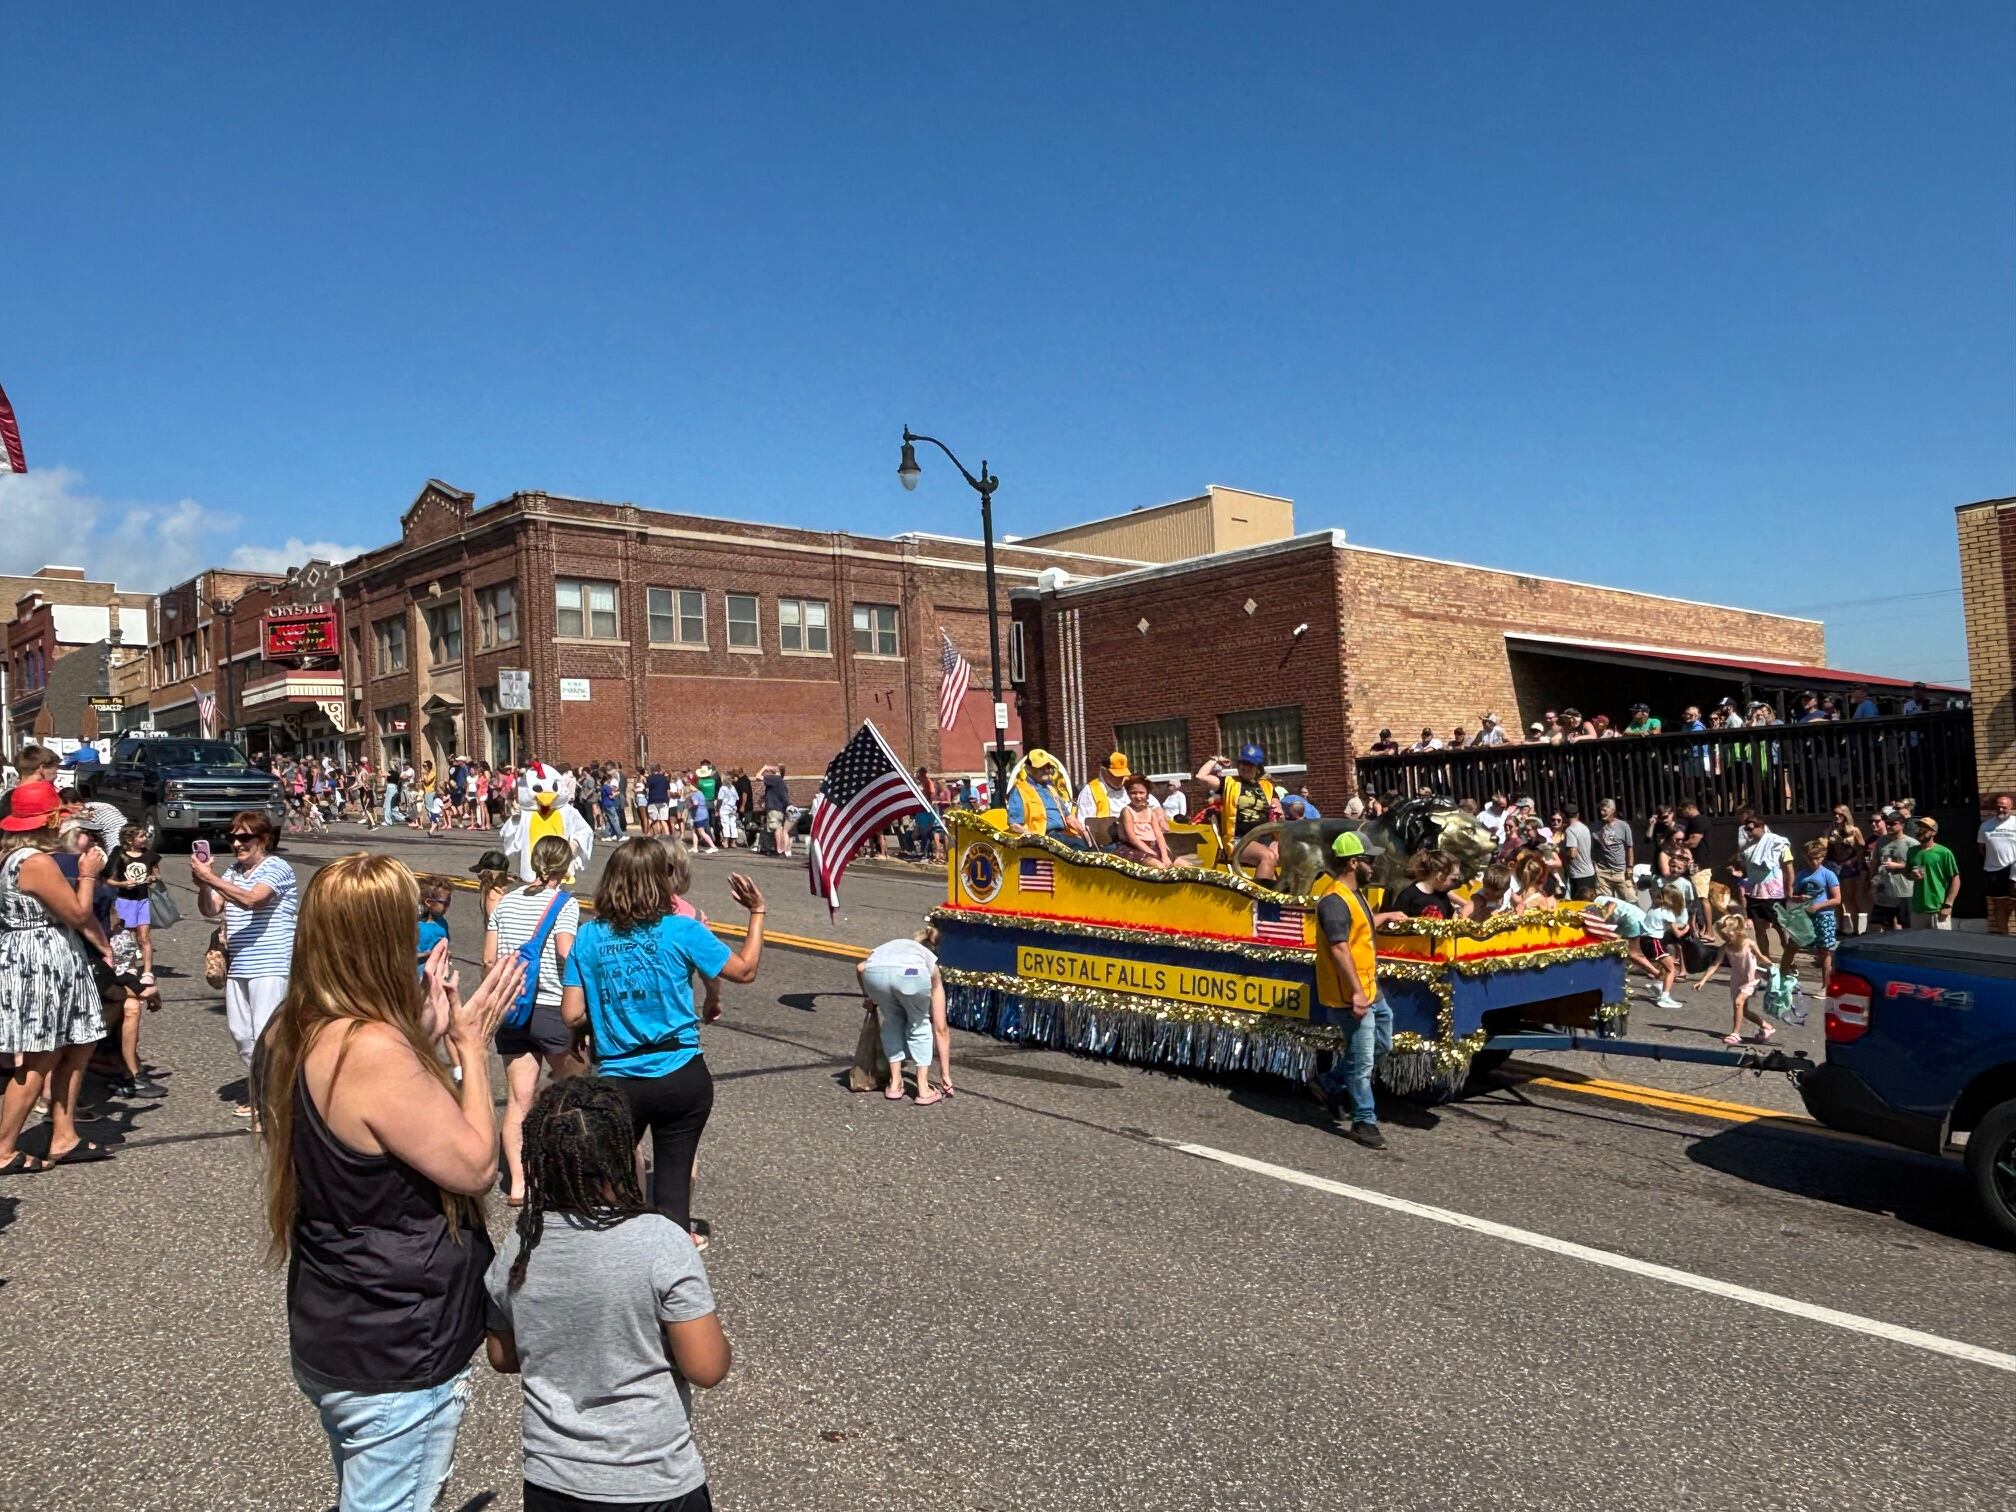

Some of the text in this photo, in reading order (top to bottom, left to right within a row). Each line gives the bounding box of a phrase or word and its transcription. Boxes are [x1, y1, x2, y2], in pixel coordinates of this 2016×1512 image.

[1023, 951, 1300, 1011] CRYSTAL FALLS LIONS CLUB
[1886, 980, 1973, 1010] FX4
